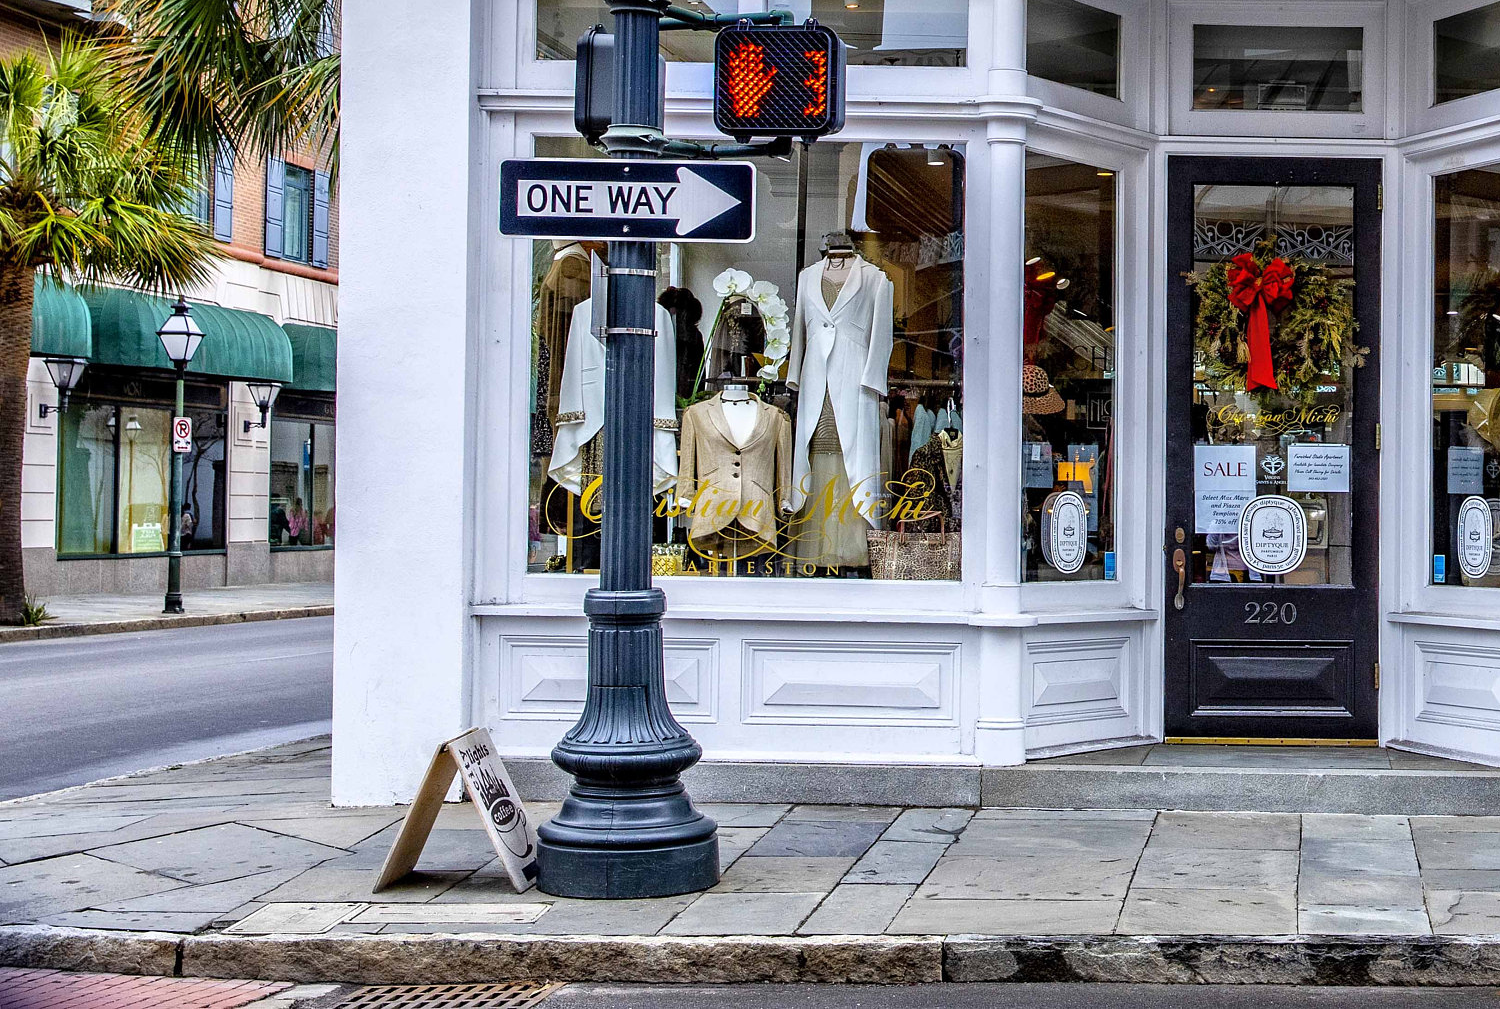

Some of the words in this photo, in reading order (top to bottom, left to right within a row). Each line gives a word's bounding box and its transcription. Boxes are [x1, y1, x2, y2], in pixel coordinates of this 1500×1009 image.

[527, 183, 593, 213] ONE
[608, 185, 678, 215] WAY
[1282, 404, 1340, 425] Michi
[1203, 462, 1248, 477] SALE
[546, 474, 764, 536] Cistian
[776, 468, 936, 526] Michi
[1260, 499, 1285, 507] diptyque
[1292, 507, 1302, 534] boulevard
[664, 560, 840, 576] HARLESTON
[1244, 602, 1297, 624] 220
[466, 744, 490, 766] lights
[494, 804, 513, 823] coffee
